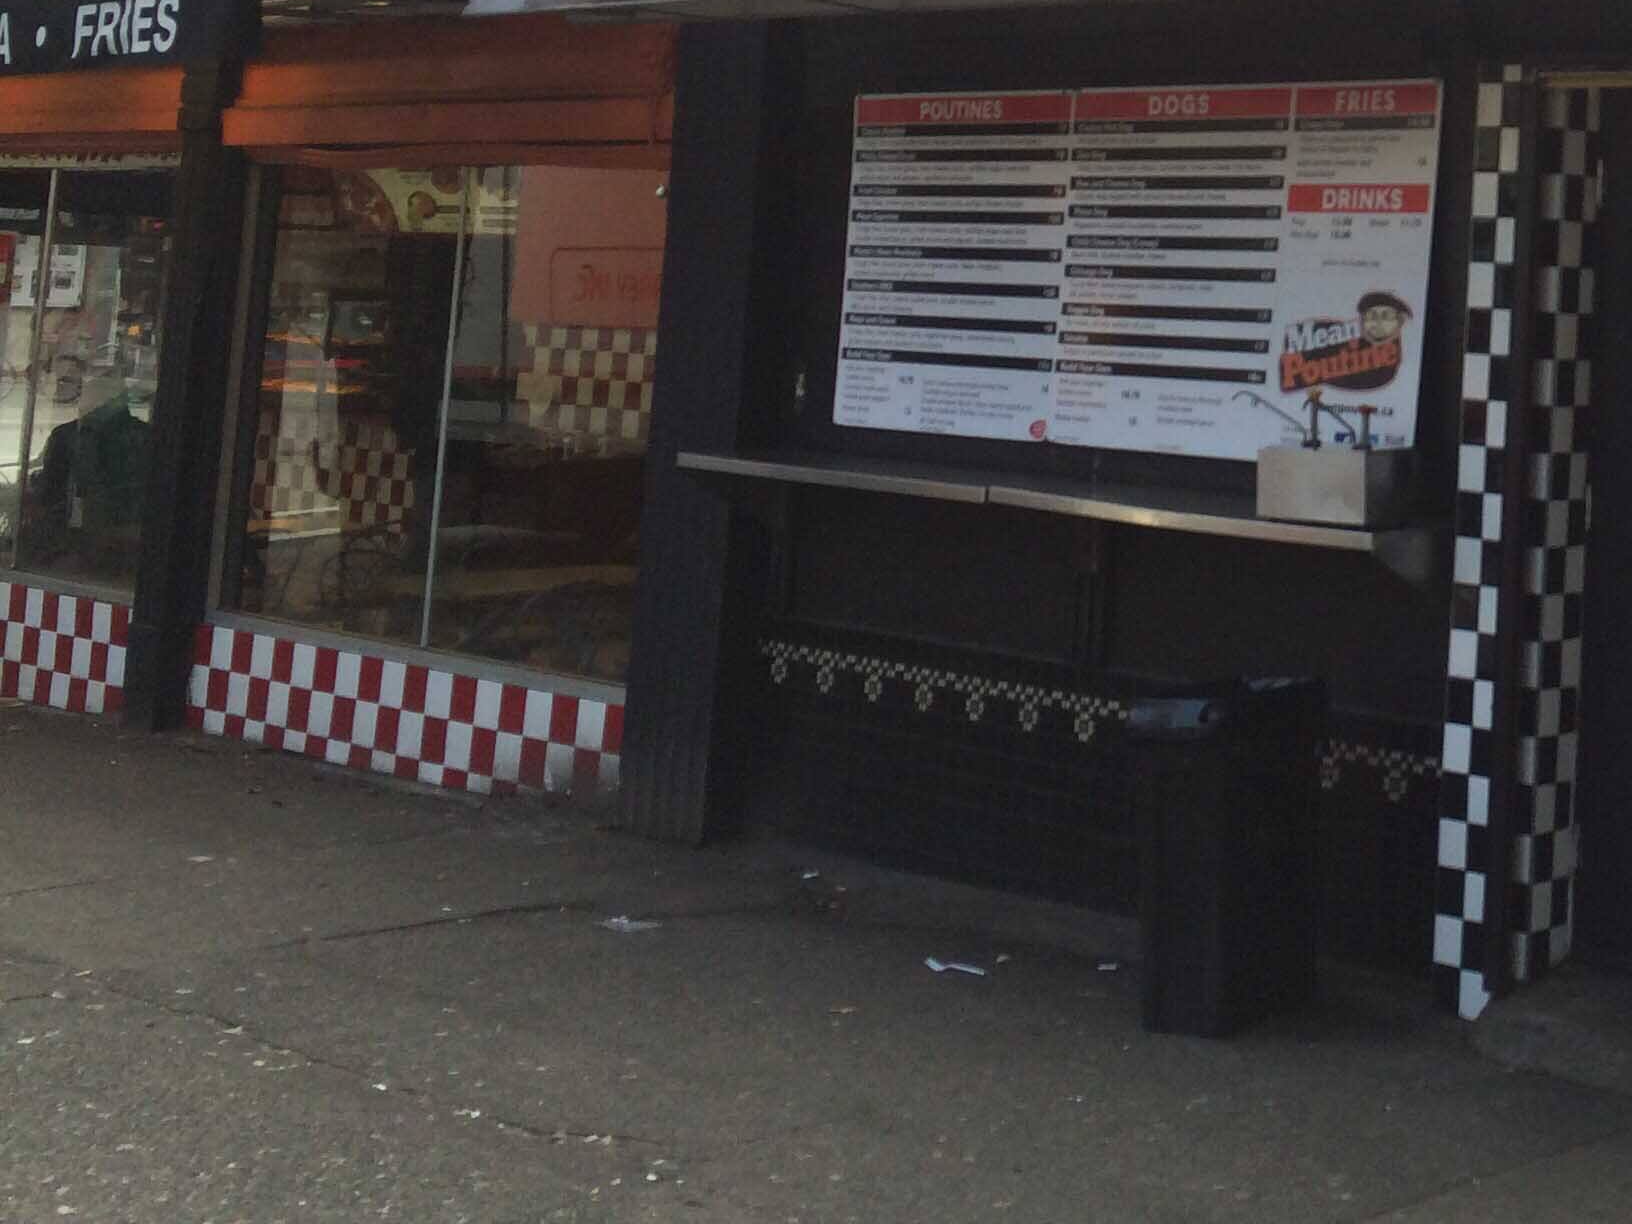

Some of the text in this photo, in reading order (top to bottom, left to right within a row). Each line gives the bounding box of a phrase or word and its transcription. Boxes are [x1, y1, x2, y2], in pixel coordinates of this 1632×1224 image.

[919, 89, 1397, 120] POUTINES DOGS FRIES
[1321, 187, 1404, 211] DRINKS
[1285, 316, 1362, 354] Mean
[1280, 339, 1398, 391] Poutine
